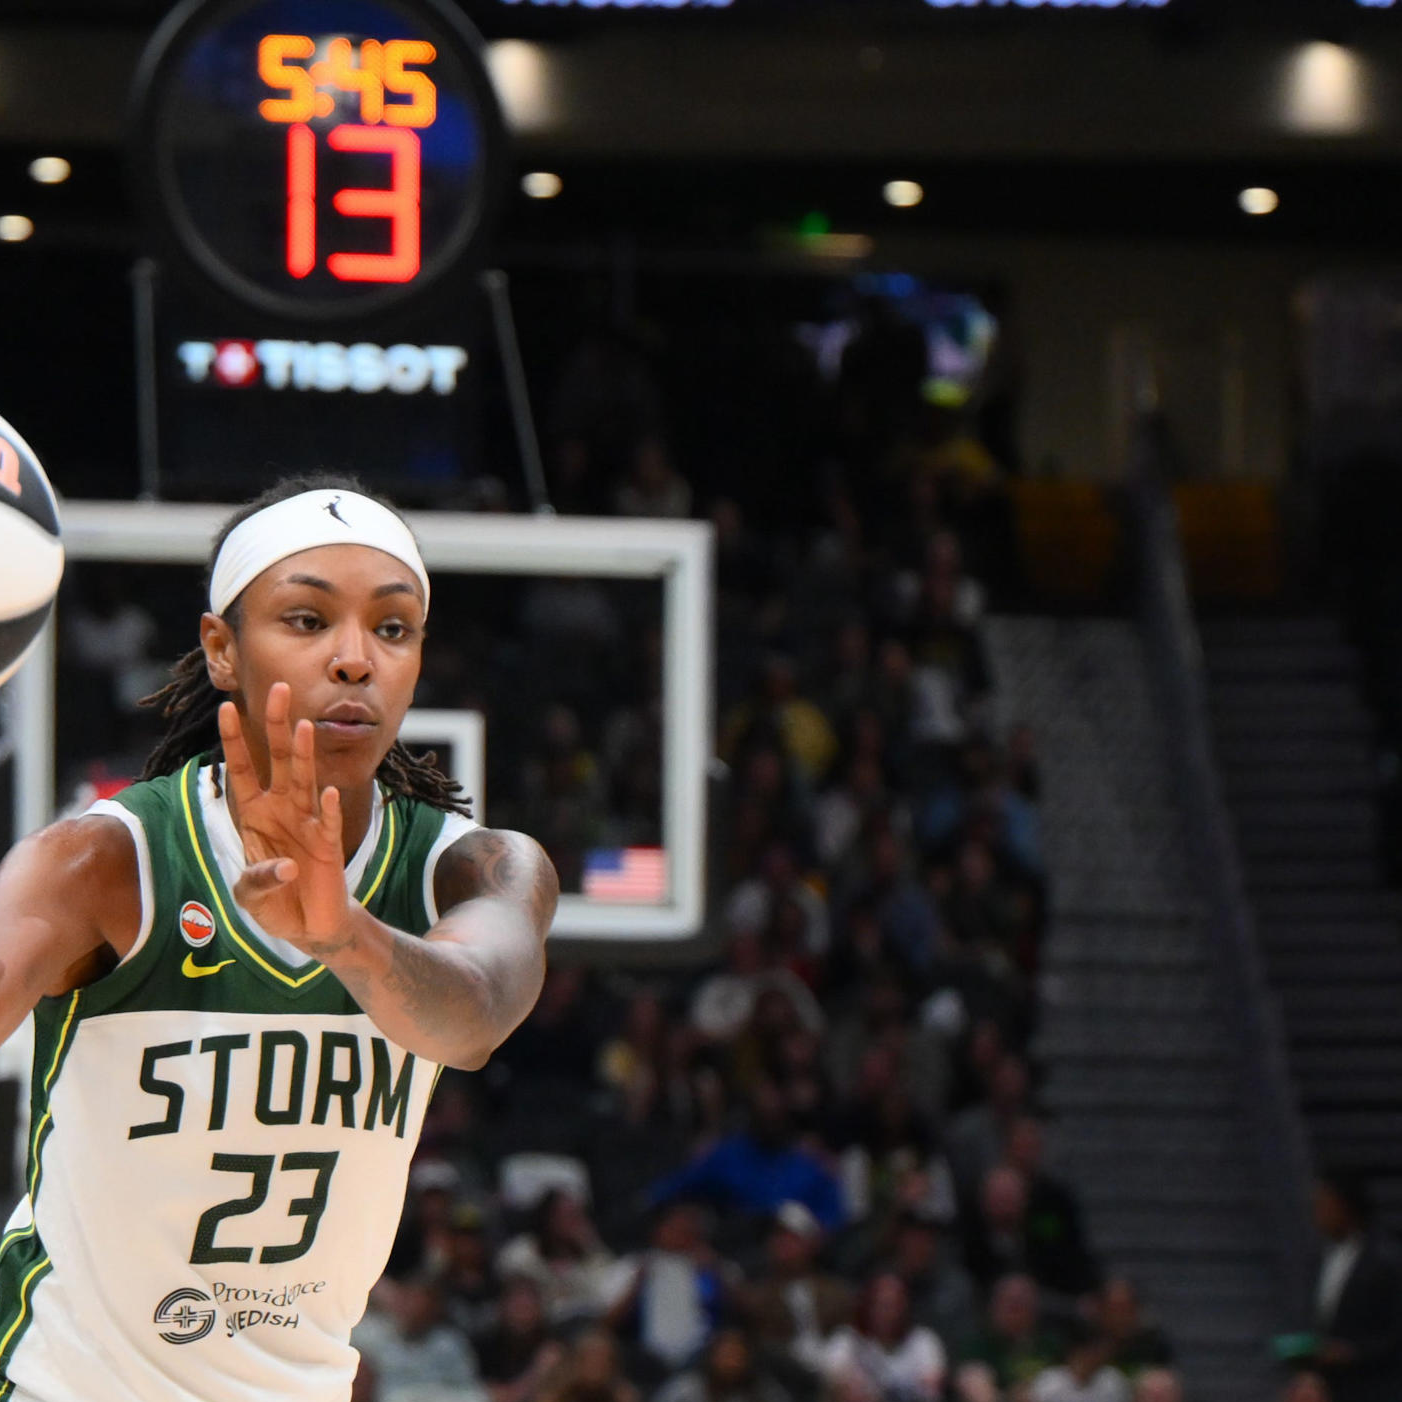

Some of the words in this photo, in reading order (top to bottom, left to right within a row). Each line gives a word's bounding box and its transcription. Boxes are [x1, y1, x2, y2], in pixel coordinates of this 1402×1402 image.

[286, 122, 422, 283] 13
[256, 339, 468, 395] TISSOT
[127, 1030, 416, 1140] STORM
[188, 1151, 340, 1265] 23
